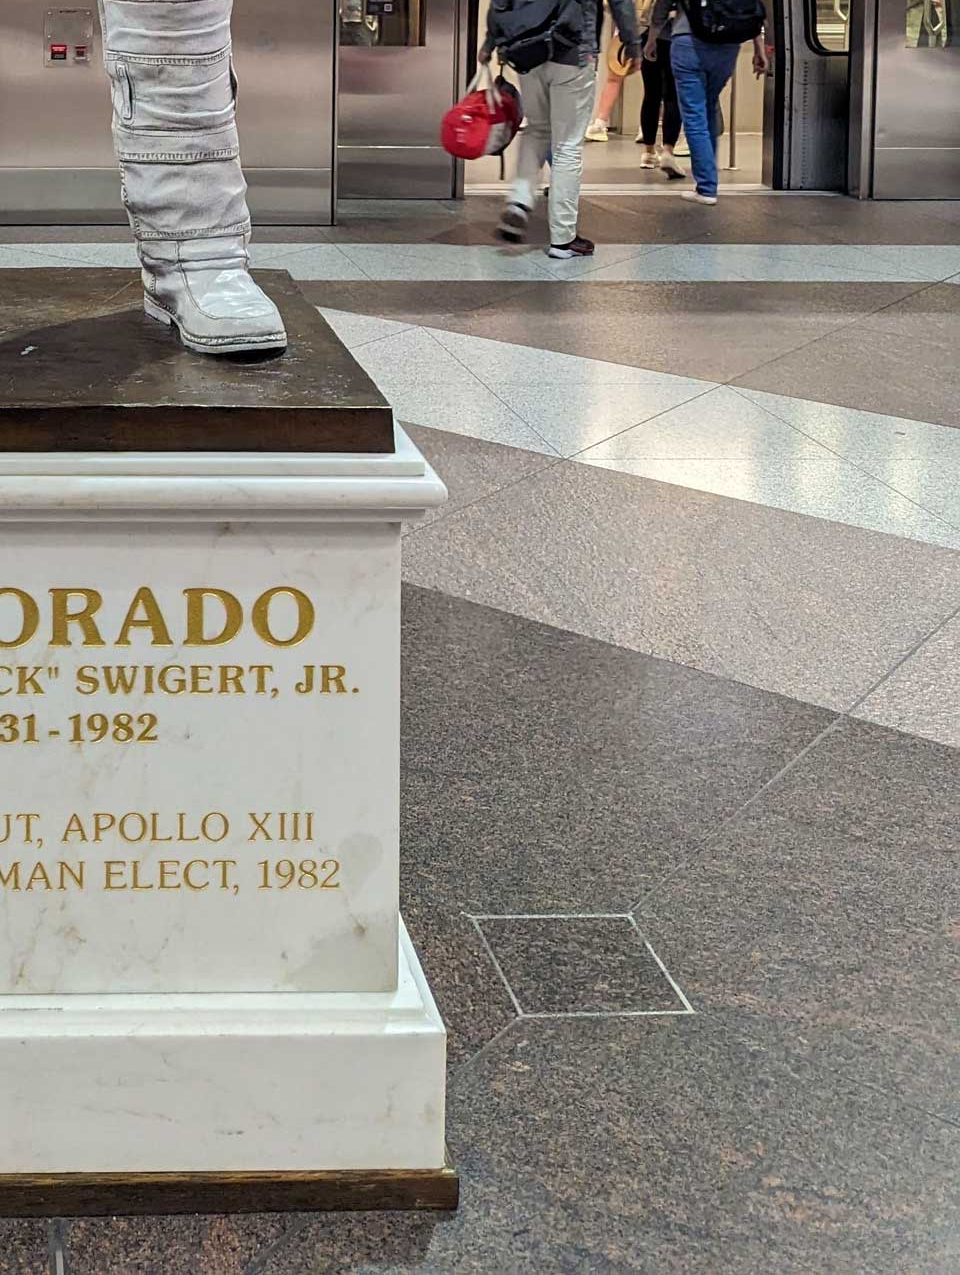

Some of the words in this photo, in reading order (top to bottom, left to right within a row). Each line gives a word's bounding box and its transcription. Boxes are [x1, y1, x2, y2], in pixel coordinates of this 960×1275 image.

[76, 664, 279, 699] SWIGERT,
[295, 664, 360, 696] JR.
[62, 812, 231, 844] APOLLO
[249, 812, 315, 843] XIII
[104, 860, 240, 894] ELECT,
[260, 859, 341, 891] 1982
